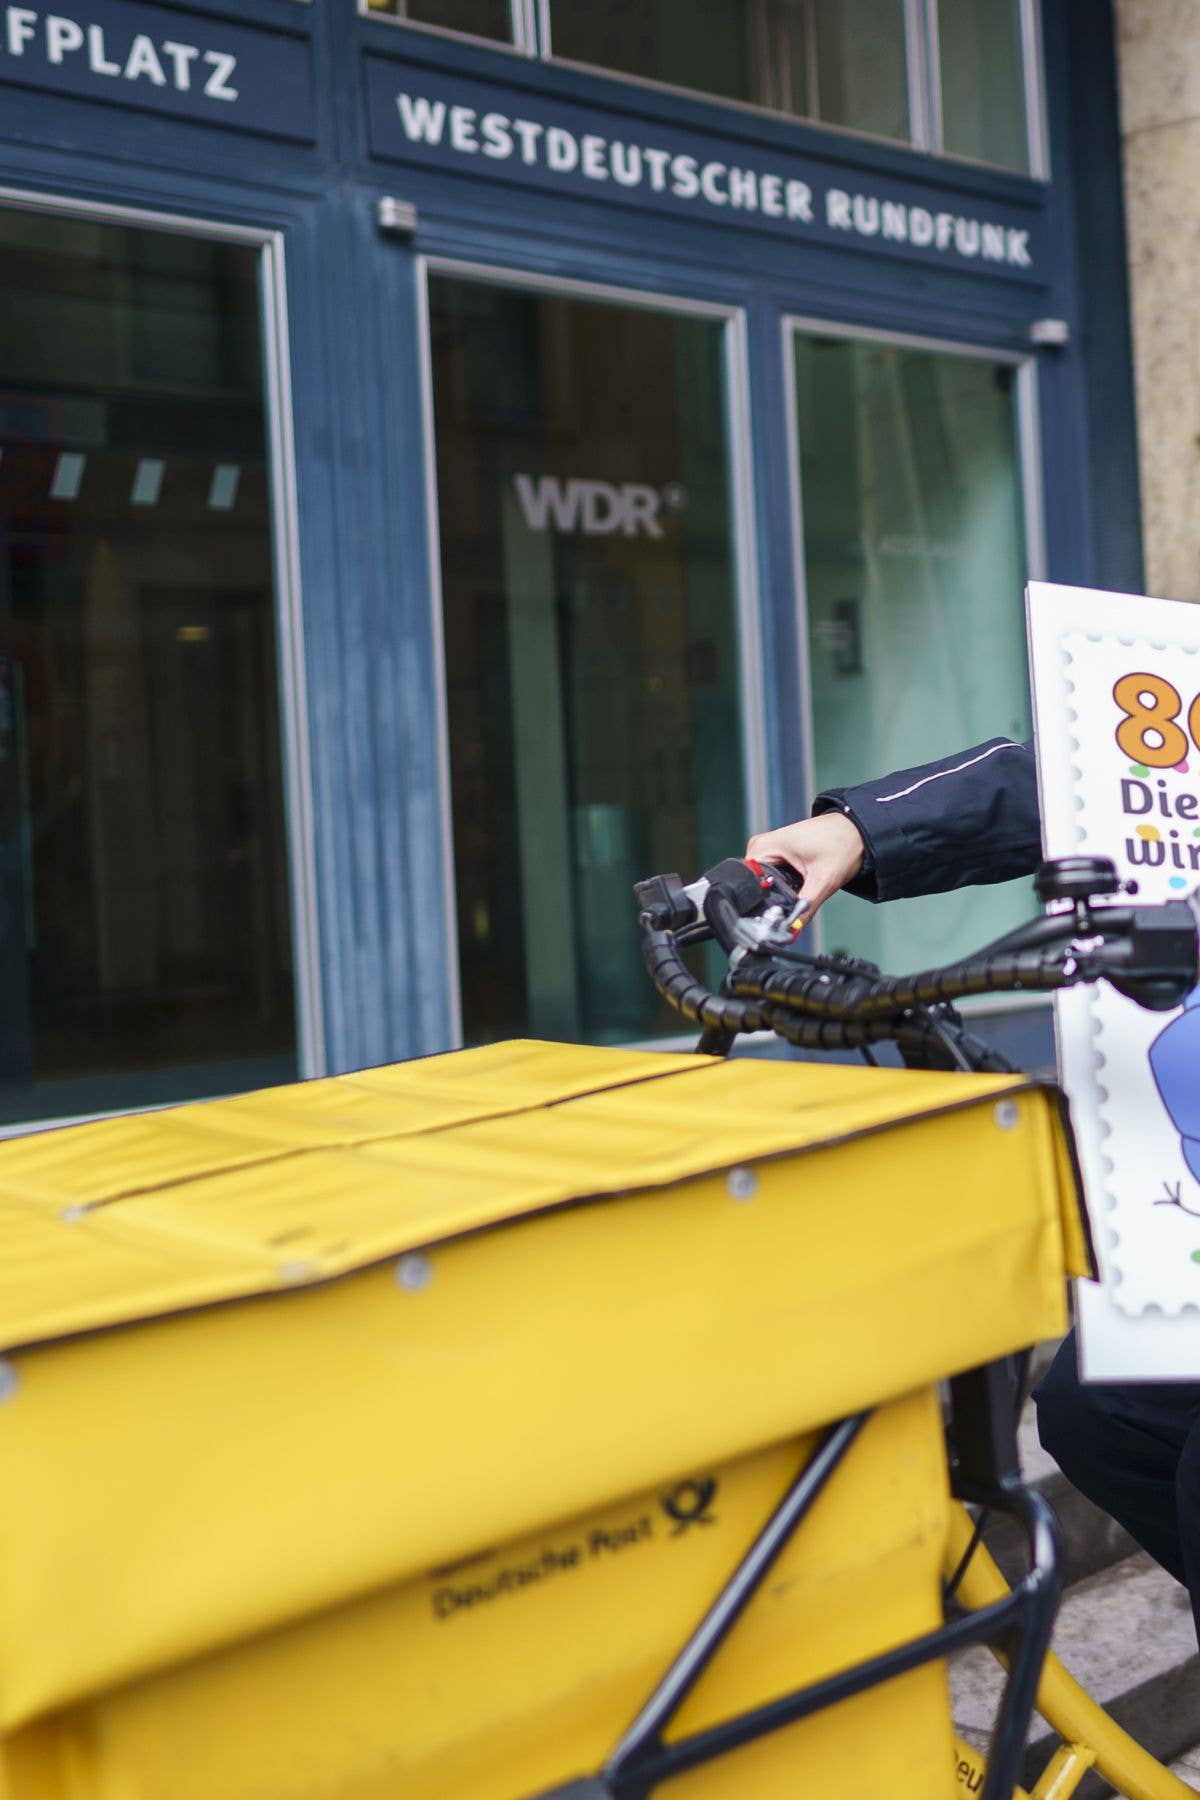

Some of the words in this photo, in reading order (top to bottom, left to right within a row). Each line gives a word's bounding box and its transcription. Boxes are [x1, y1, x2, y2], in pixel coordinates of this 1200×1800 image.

[0, 6, 240, 101] FPLATZ
[397, 93, 814, 221] WESTDEUTSCHER
[826, 189, 1032, 267] RUNDFUNK
[513, 472, 665, 539] WDR
[1120, 777, 1199, 820] Die
[587, 1515, 653, 1555] Post
